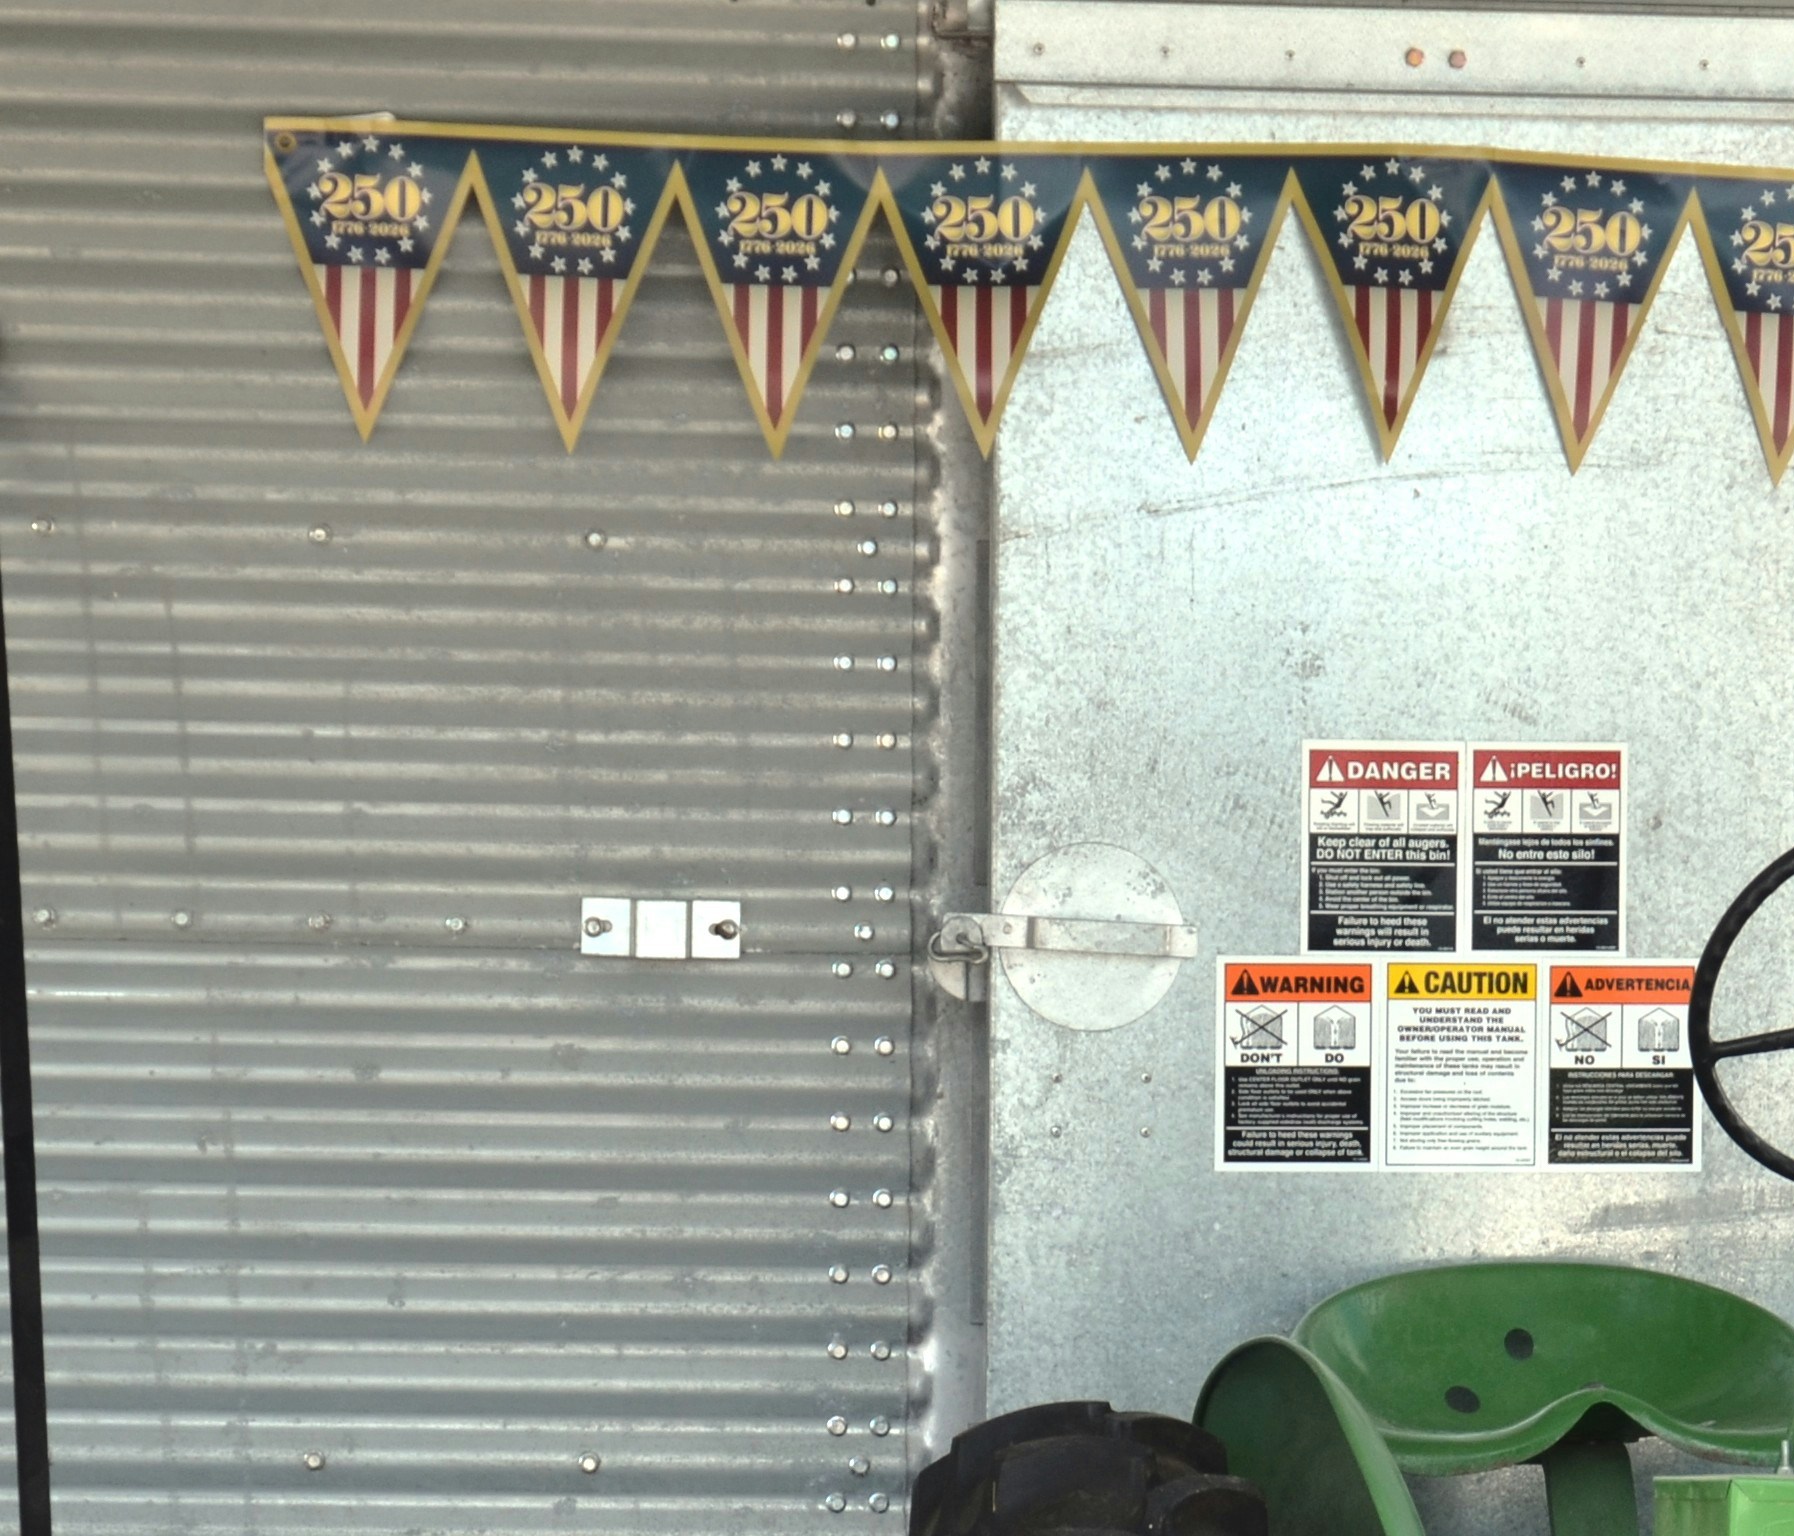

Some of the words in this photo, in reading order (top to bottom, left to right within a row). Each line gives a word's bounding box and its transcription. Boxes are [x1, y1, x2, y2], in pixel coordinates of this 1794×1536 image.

[319, 173, 423, 222] 250
[523, 182, 624, 232] 250
[726, 190, 830, 241] 250
[932, 195, 1036, 242] 250
[1139, 196, 1241, 241] 250
[1344, 196, 1442, 243] 250
[1542, 205, 1642, 254] 250
[1347, 762, 1451, 781] DANGER
[1510, 762, 1616, 780] ¡PELIGRO!
[1318, 836, 1346, 849] Keep
[1348, 836, 1376, 849] clear
[1378, 836, 1390, 849] of
[1392, 836, 1406, 849] all
[1408, 836, 1448, 849] augers.
[1316, 850, 1334, 860] DO
[1336, 850, 1361, 860] NOT
[1363, 850, 1403, 860] ENTER
[1405, 850, 1427, 860] this
[1429, 850, 1450, 860] bin!
[1498, 850, 1514, 859] No
[1516, 850, 1544, 859] entre
[1546, 850, 1570, 859] este
[1572, 850, 1595, 859] silo!
[1338, 916, 1368, 926] Failure
[1370, 916, 1378, 926] to
[1380, 916, 1402, 926] heed
[1404, 916, 1428, 926] these
[1336, 928, 1375, 936] warnings
[1377, 928, 1392, 936] will
[1394, 928, 1419, 936] result
[1421, 928, 1429, 936] in
[1333, 938, 1365, 948] serious
[1367, 938, 1392, 948] injury
[1394, 938, 1403, 948] or
[1405, 938, 1431, 948] death.
[1260, 976, 1364, 994] WARNING
[1424, 970, 1528, 995] CAUTION
[1585, 978, 1690, 992] ADVERTENCIA
[1420, 1016, 1483, 1024] UNDERSTAND
[1485, 1016, 1504, 1024] THE
[1240, 1053, 1282, 1063] DON'T
[1325, 1053, 1344, 1063] DO
[1574, 1055, 1595, 1065] NO
[1652, 1055, 1666, 1065] SI
